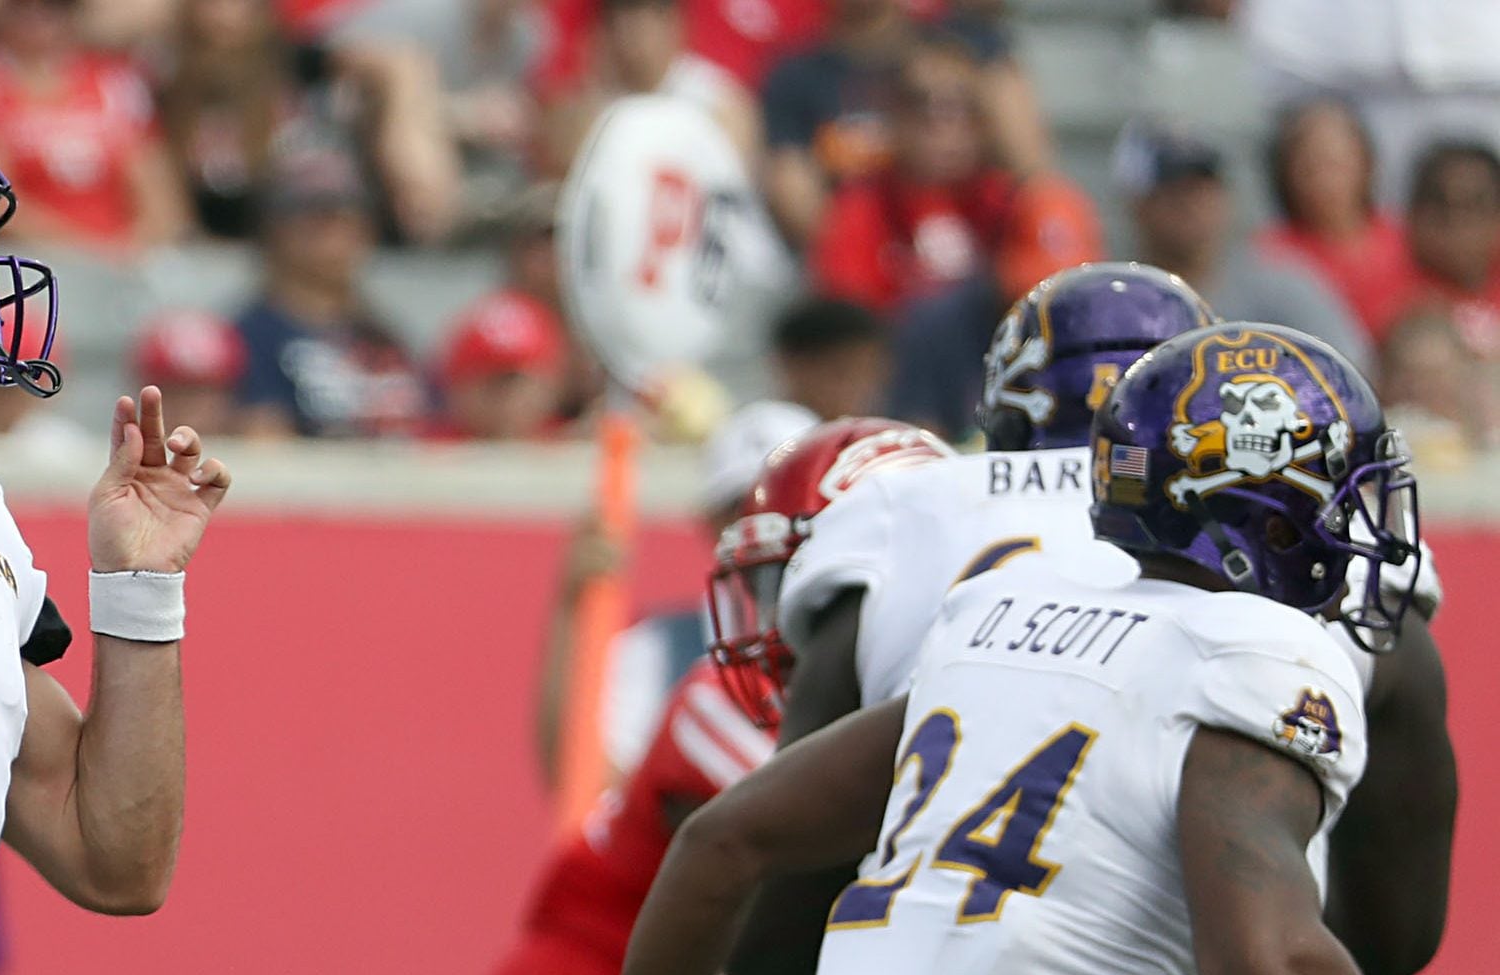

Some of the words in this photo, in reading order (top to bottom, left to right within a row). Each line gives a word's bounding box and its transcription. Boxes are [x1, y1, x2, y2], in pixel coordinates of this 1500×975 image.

[1217, 348, 1277, 374] ECU
[968, 598, 1015, 650] D.
[1007, 602, 1149, 666] SCOTT
[824, 706, 1100, 932] 24
